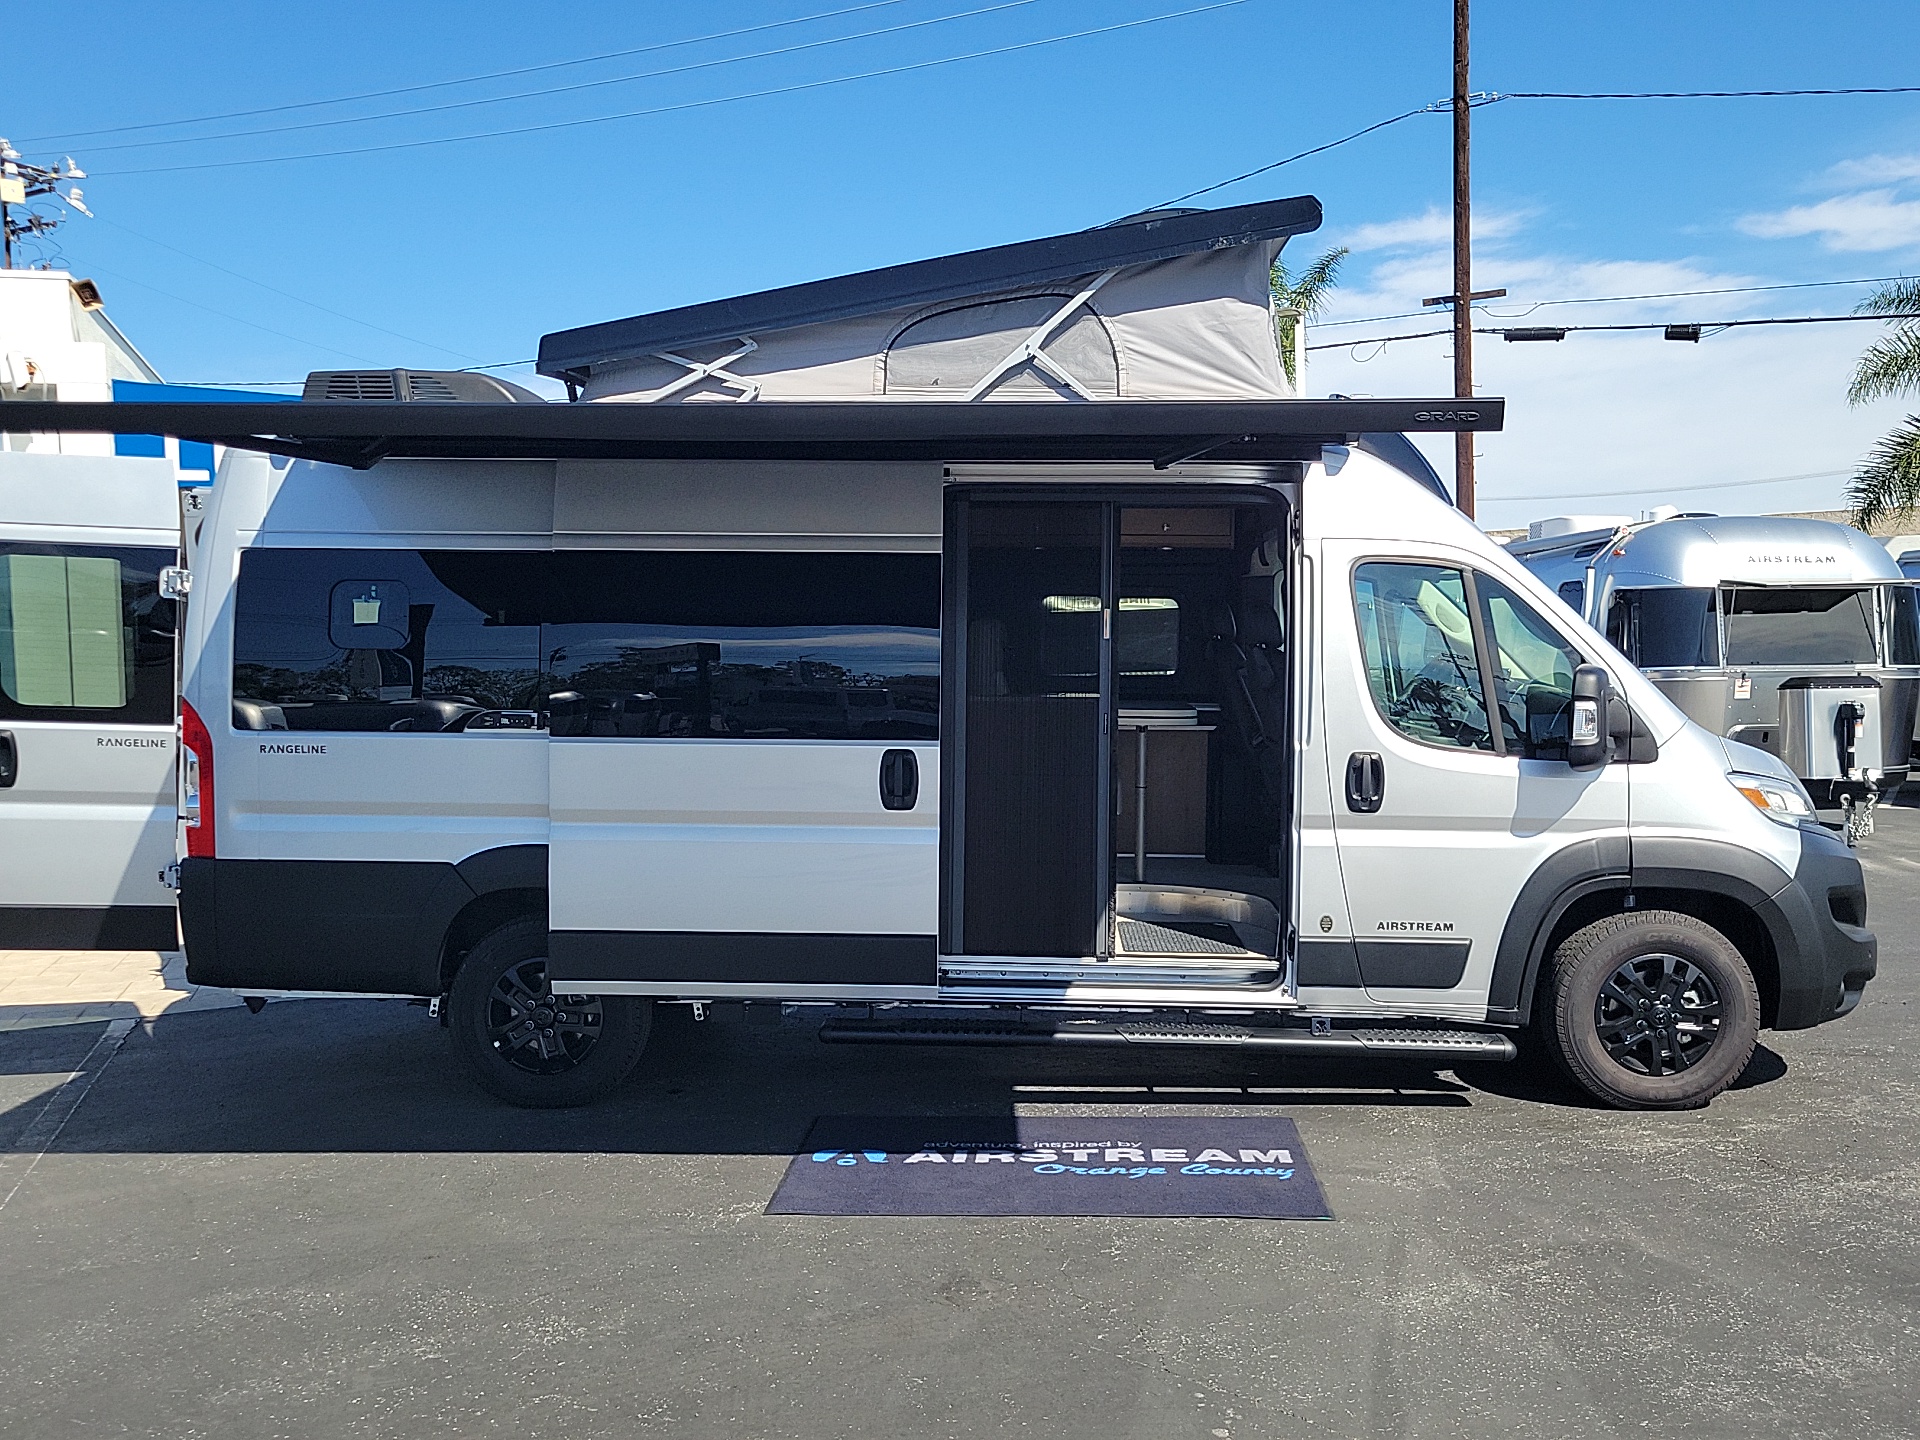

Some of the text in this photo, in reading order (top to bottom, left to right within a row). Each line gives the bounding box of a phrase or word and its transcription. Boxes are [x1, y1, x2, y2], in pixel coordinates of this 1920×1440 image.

[97, 737, 167, 748] RANGELINE
[259, 744, 327, 754] RANGELINE
[1377, 921, 1454, 932] AIRSTREAM
[1033, 1140, 1111, 1149] inspired
[1117, 1140, 1143, 1149] by
[903, 1149, 1293, 1164] AIRSTREAM
[1033, 1163, 1296, 1180] Orange County
